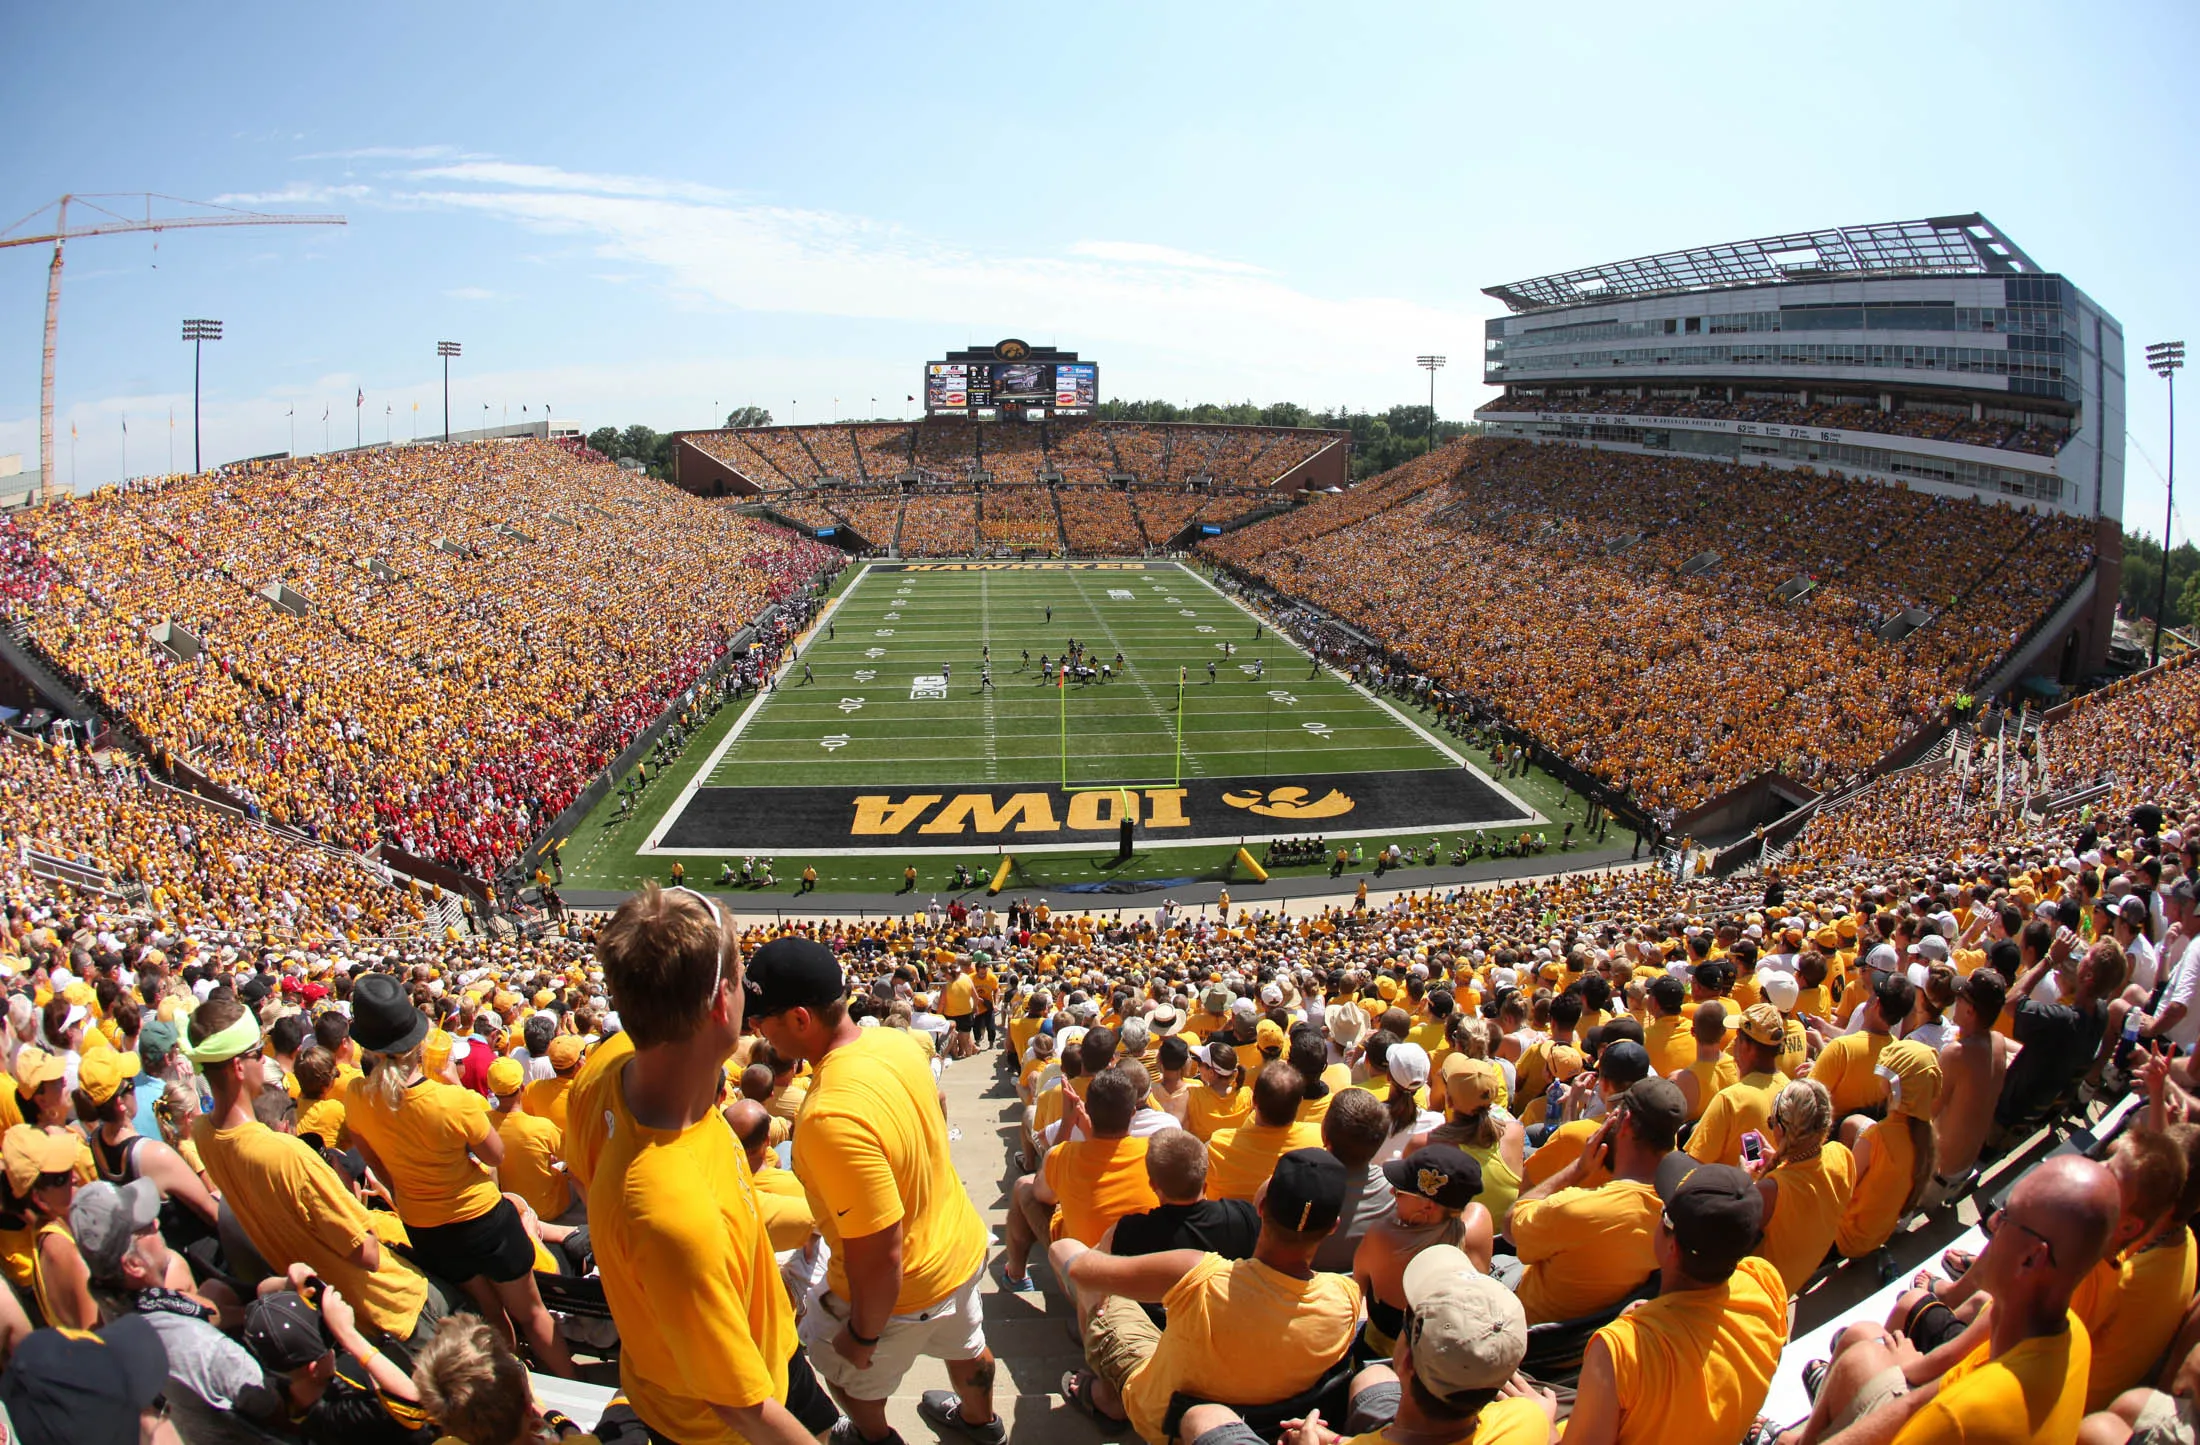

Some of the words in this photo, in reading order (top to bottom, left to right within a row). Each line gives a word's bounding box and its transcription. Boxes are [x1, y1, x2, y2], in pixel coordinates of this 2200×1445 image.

[1737, 424, 1747, 433] 62
[1789, 428, 1799, 437] 77
[1820, 431, 1830, 440] 16
[902, 563, 1145, 571] HAWKEYES
[853, 669, 877, 680] 30
[1266, 690, 1298, 702] 20
[838, 697, 865, 710] 20
[1302, 722, 1334, 736] 10
[820, 733, 850, 747] 10
[850, 788, 1191, 835] IOWA
